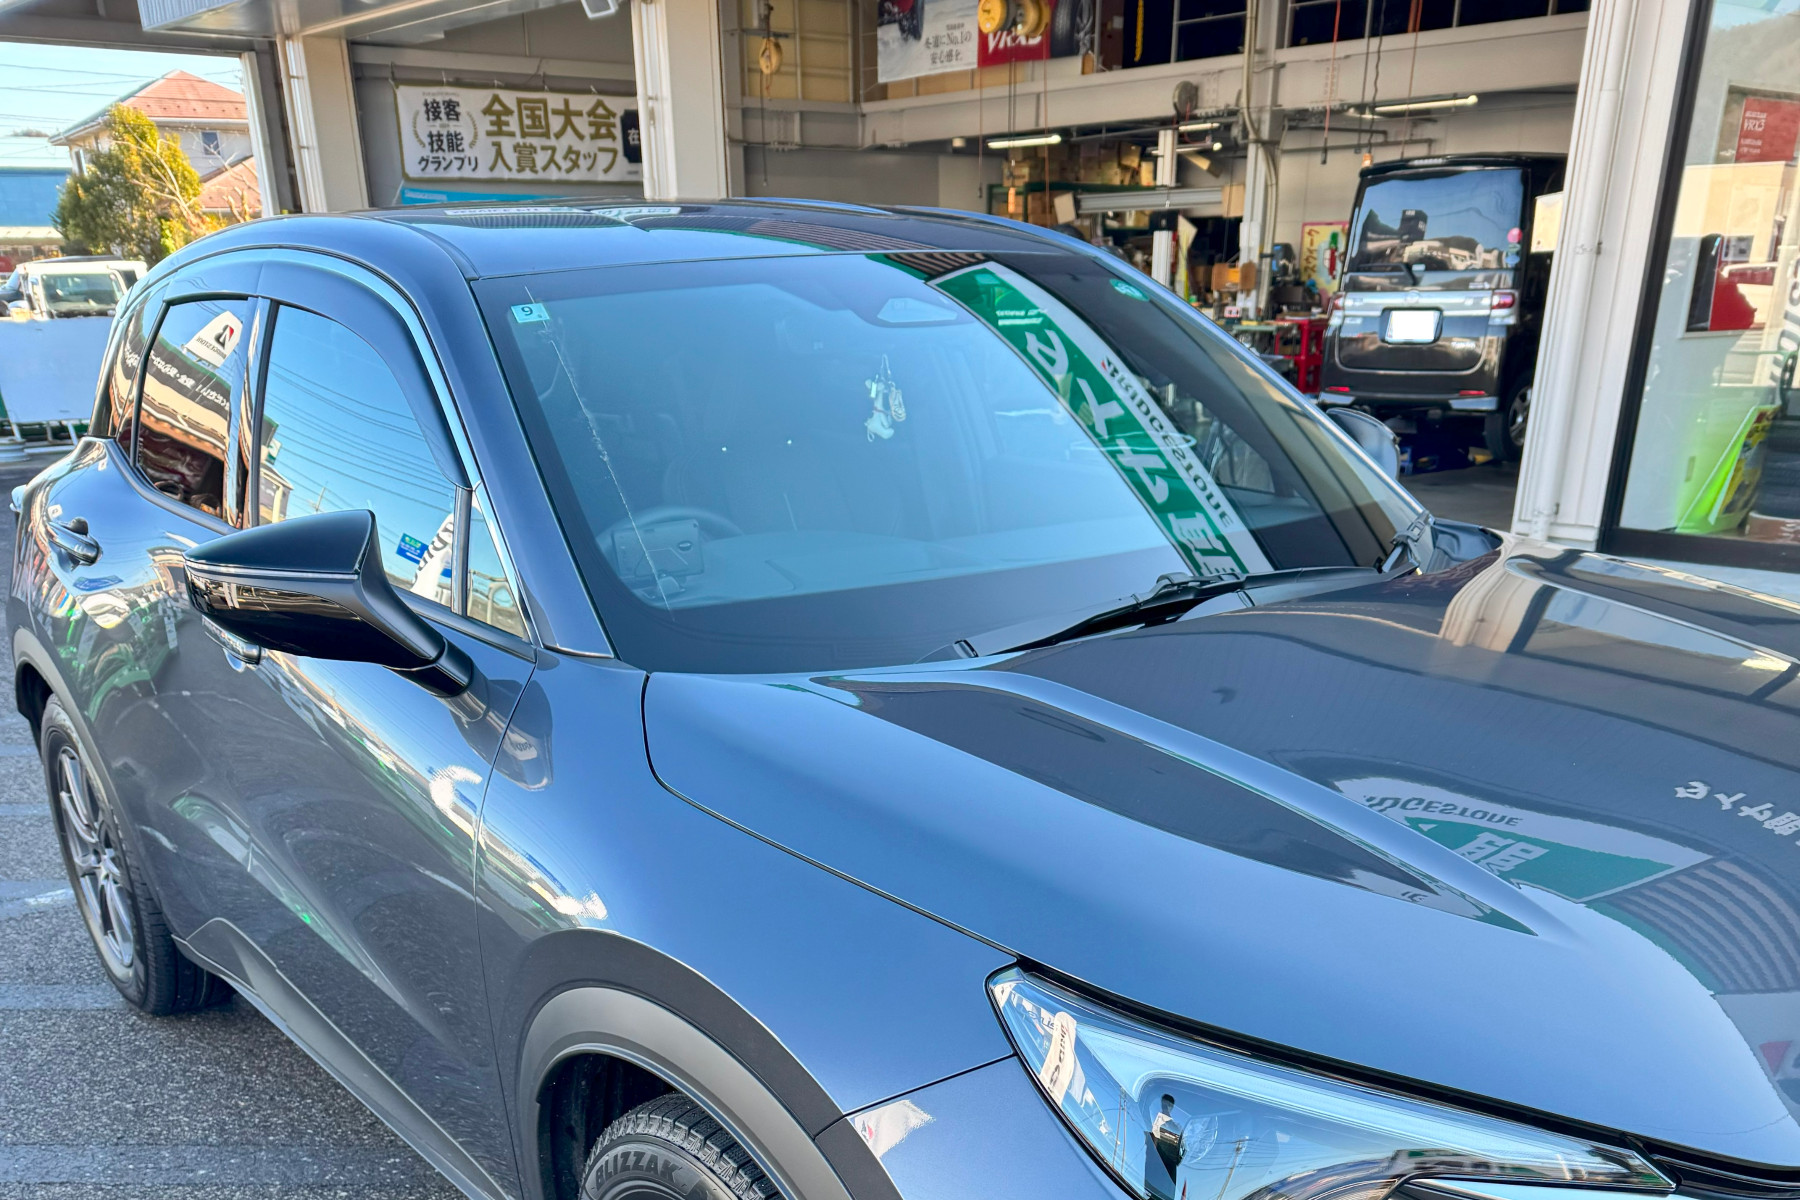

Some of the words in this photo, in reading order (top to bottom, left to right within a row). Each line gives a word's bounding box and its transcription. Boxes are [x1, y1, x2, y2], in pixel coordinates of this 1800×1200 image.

[424, 98, 461, 121] 接客
[481, 93, 617, 142] 全国大会
[427, 130, 465, 153] 技能
[418, 155, 479, 172] グランプリ
[489, 141, 618, 174] 入賞スタッフ
[521, 305, 533, 317] 9
[595, 1151, 679, 1191] BLIZZAK
